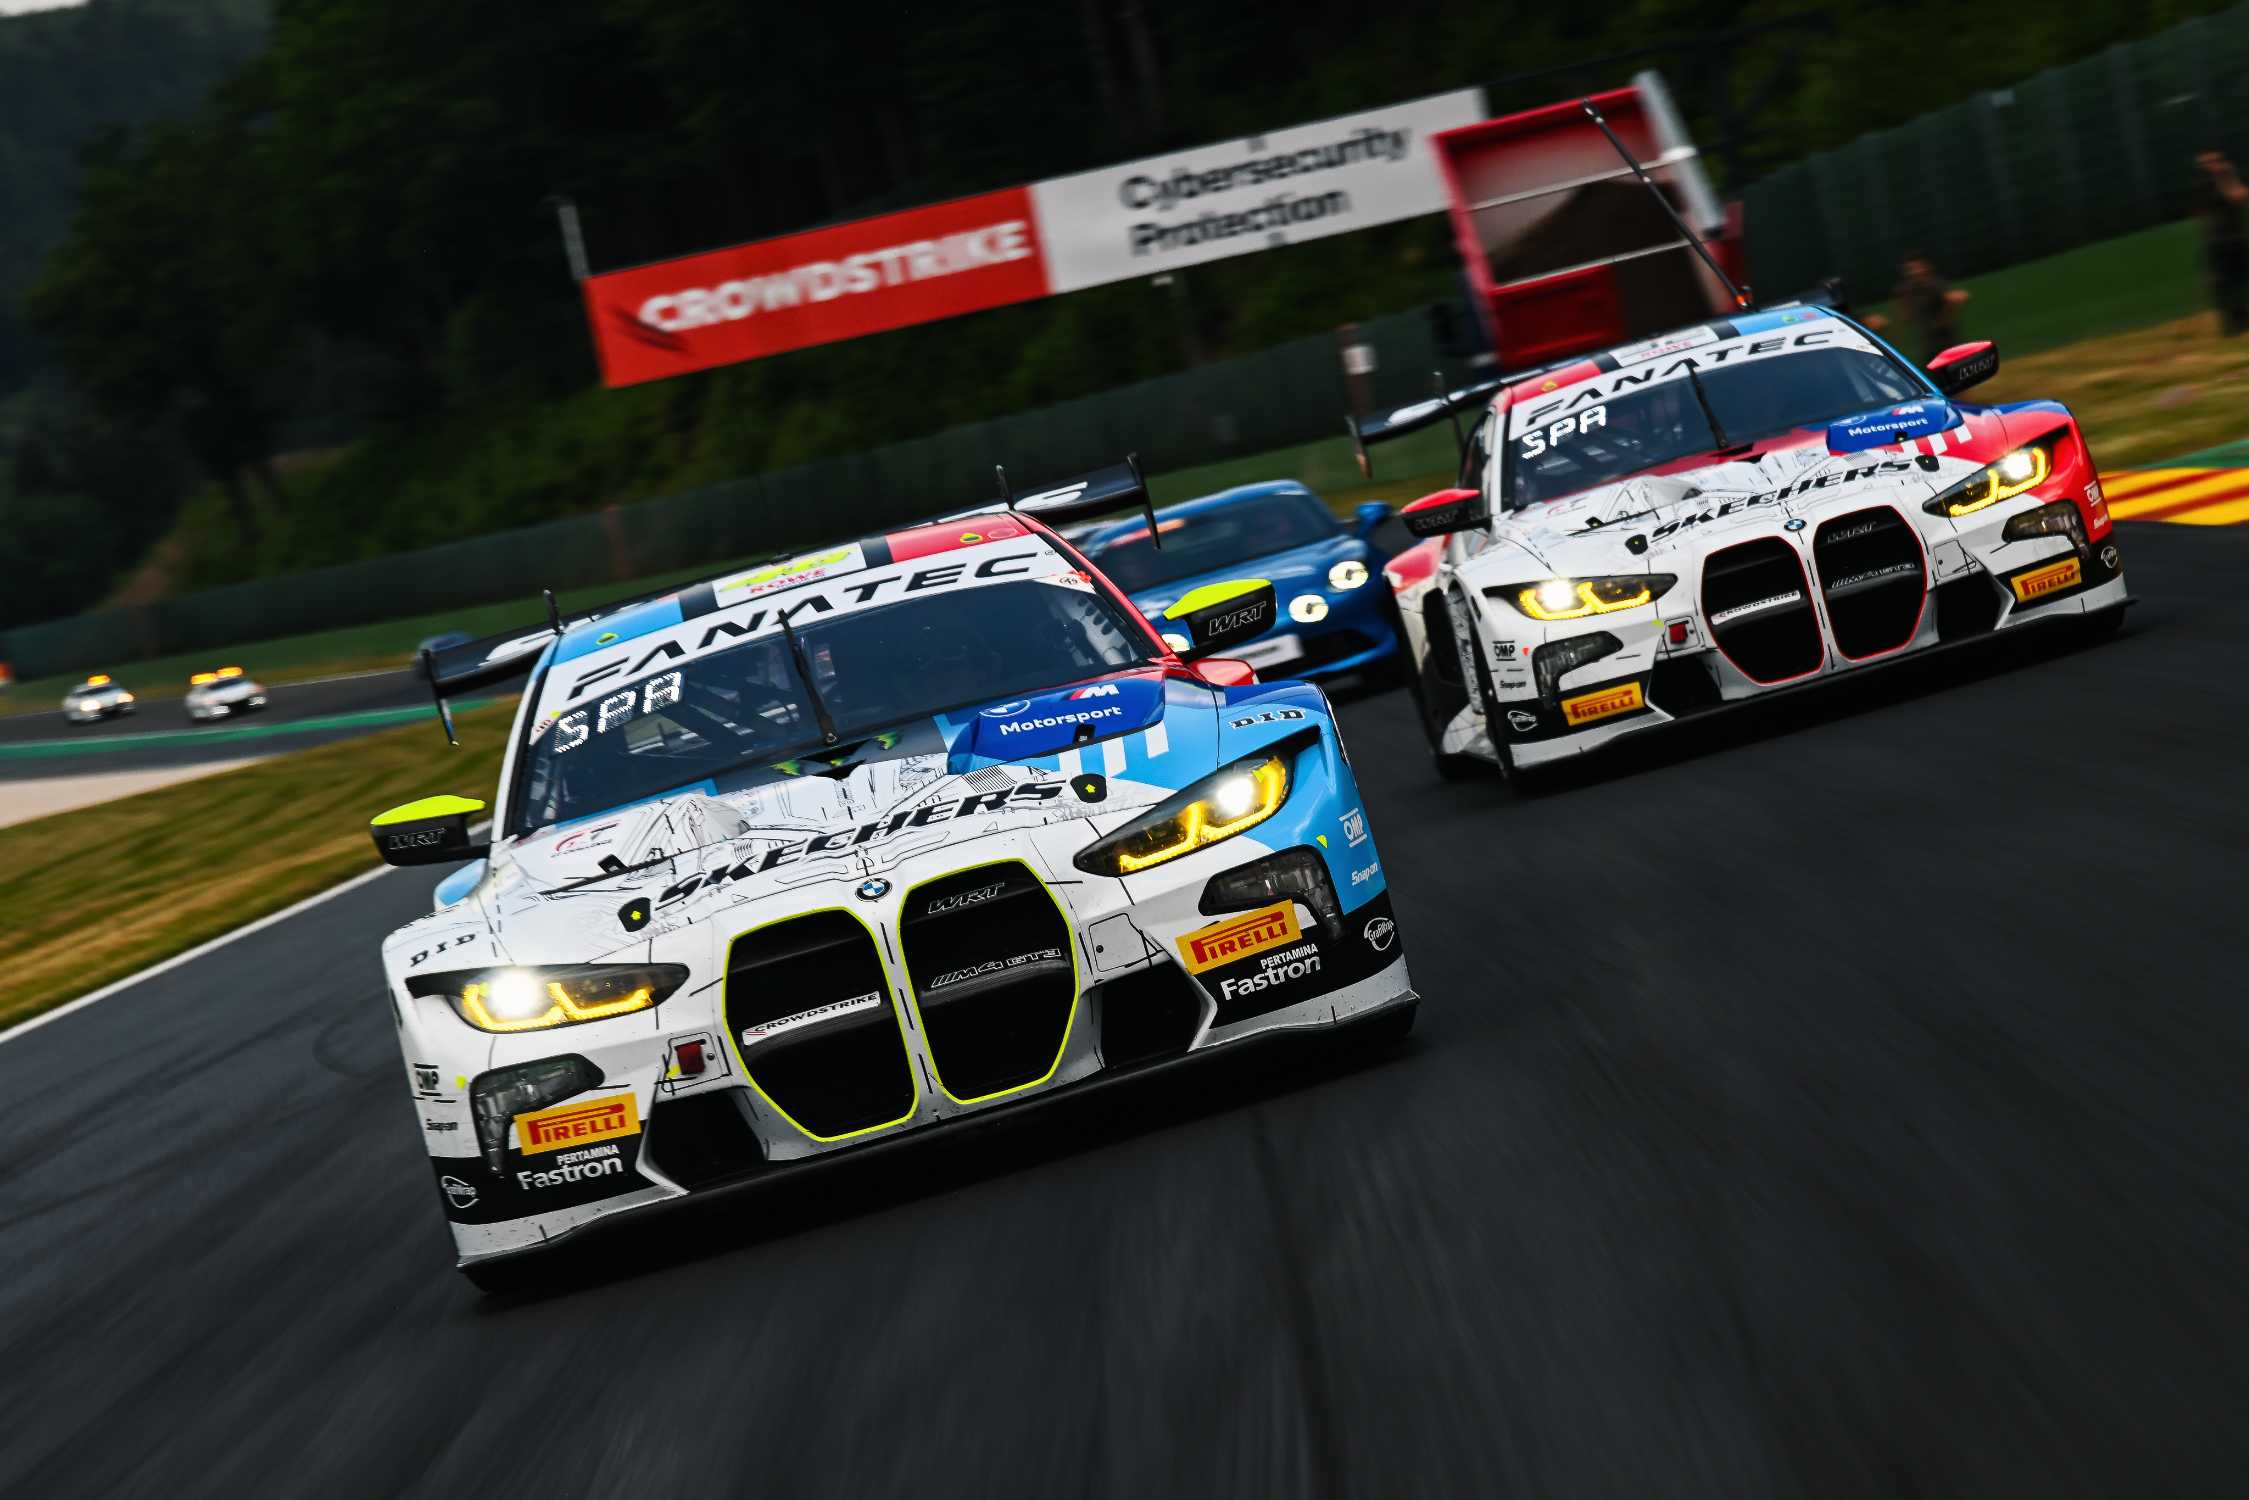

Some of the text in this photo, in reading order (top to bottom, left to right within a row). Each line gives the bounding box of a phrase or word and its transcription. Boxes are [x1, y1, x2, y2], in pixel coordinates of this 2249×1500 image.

[1119, 126, 1412, 212] Cybersecurity
[1129, 188, 1351, 257] Protection
[638, 220, 1032, 332] CROWDSTRIKE
[1526, 331, 1833, 426] FANATEC
[1521, 405, 1606, 460] SPA
[1848, 417, 1928, 437] Motorsport
[1650, 458, 1911, 543] SKECHERS
[567, 551, 1039, 701] FANATEC
[1208, 600, 1267, 636] WRT
[554, 671, 682, 754] SPA
[1000, 706, 1122, 736] Motorsport
[1570, 690, 1635, 720] PIRELLI
[655, 779, 1066, 911] SKECHERS
[1344, 815, 1364, 841] OMP
[927, 882, 1006, 914] WRT
[1190, 911, 1288, 965] PIRELLI
[1260, 943, 1319, 970] PERTAMINA
[1220, 956, 1321, 1000] Fastron
[754, 992, 878, 1033] CROWDSTRIKE
[527, 1103, 626, 1146] PIRELLI
[516, 1156, 624, 1190] Fastron
[556, 1144, 621, 1166] PERTAMINA
